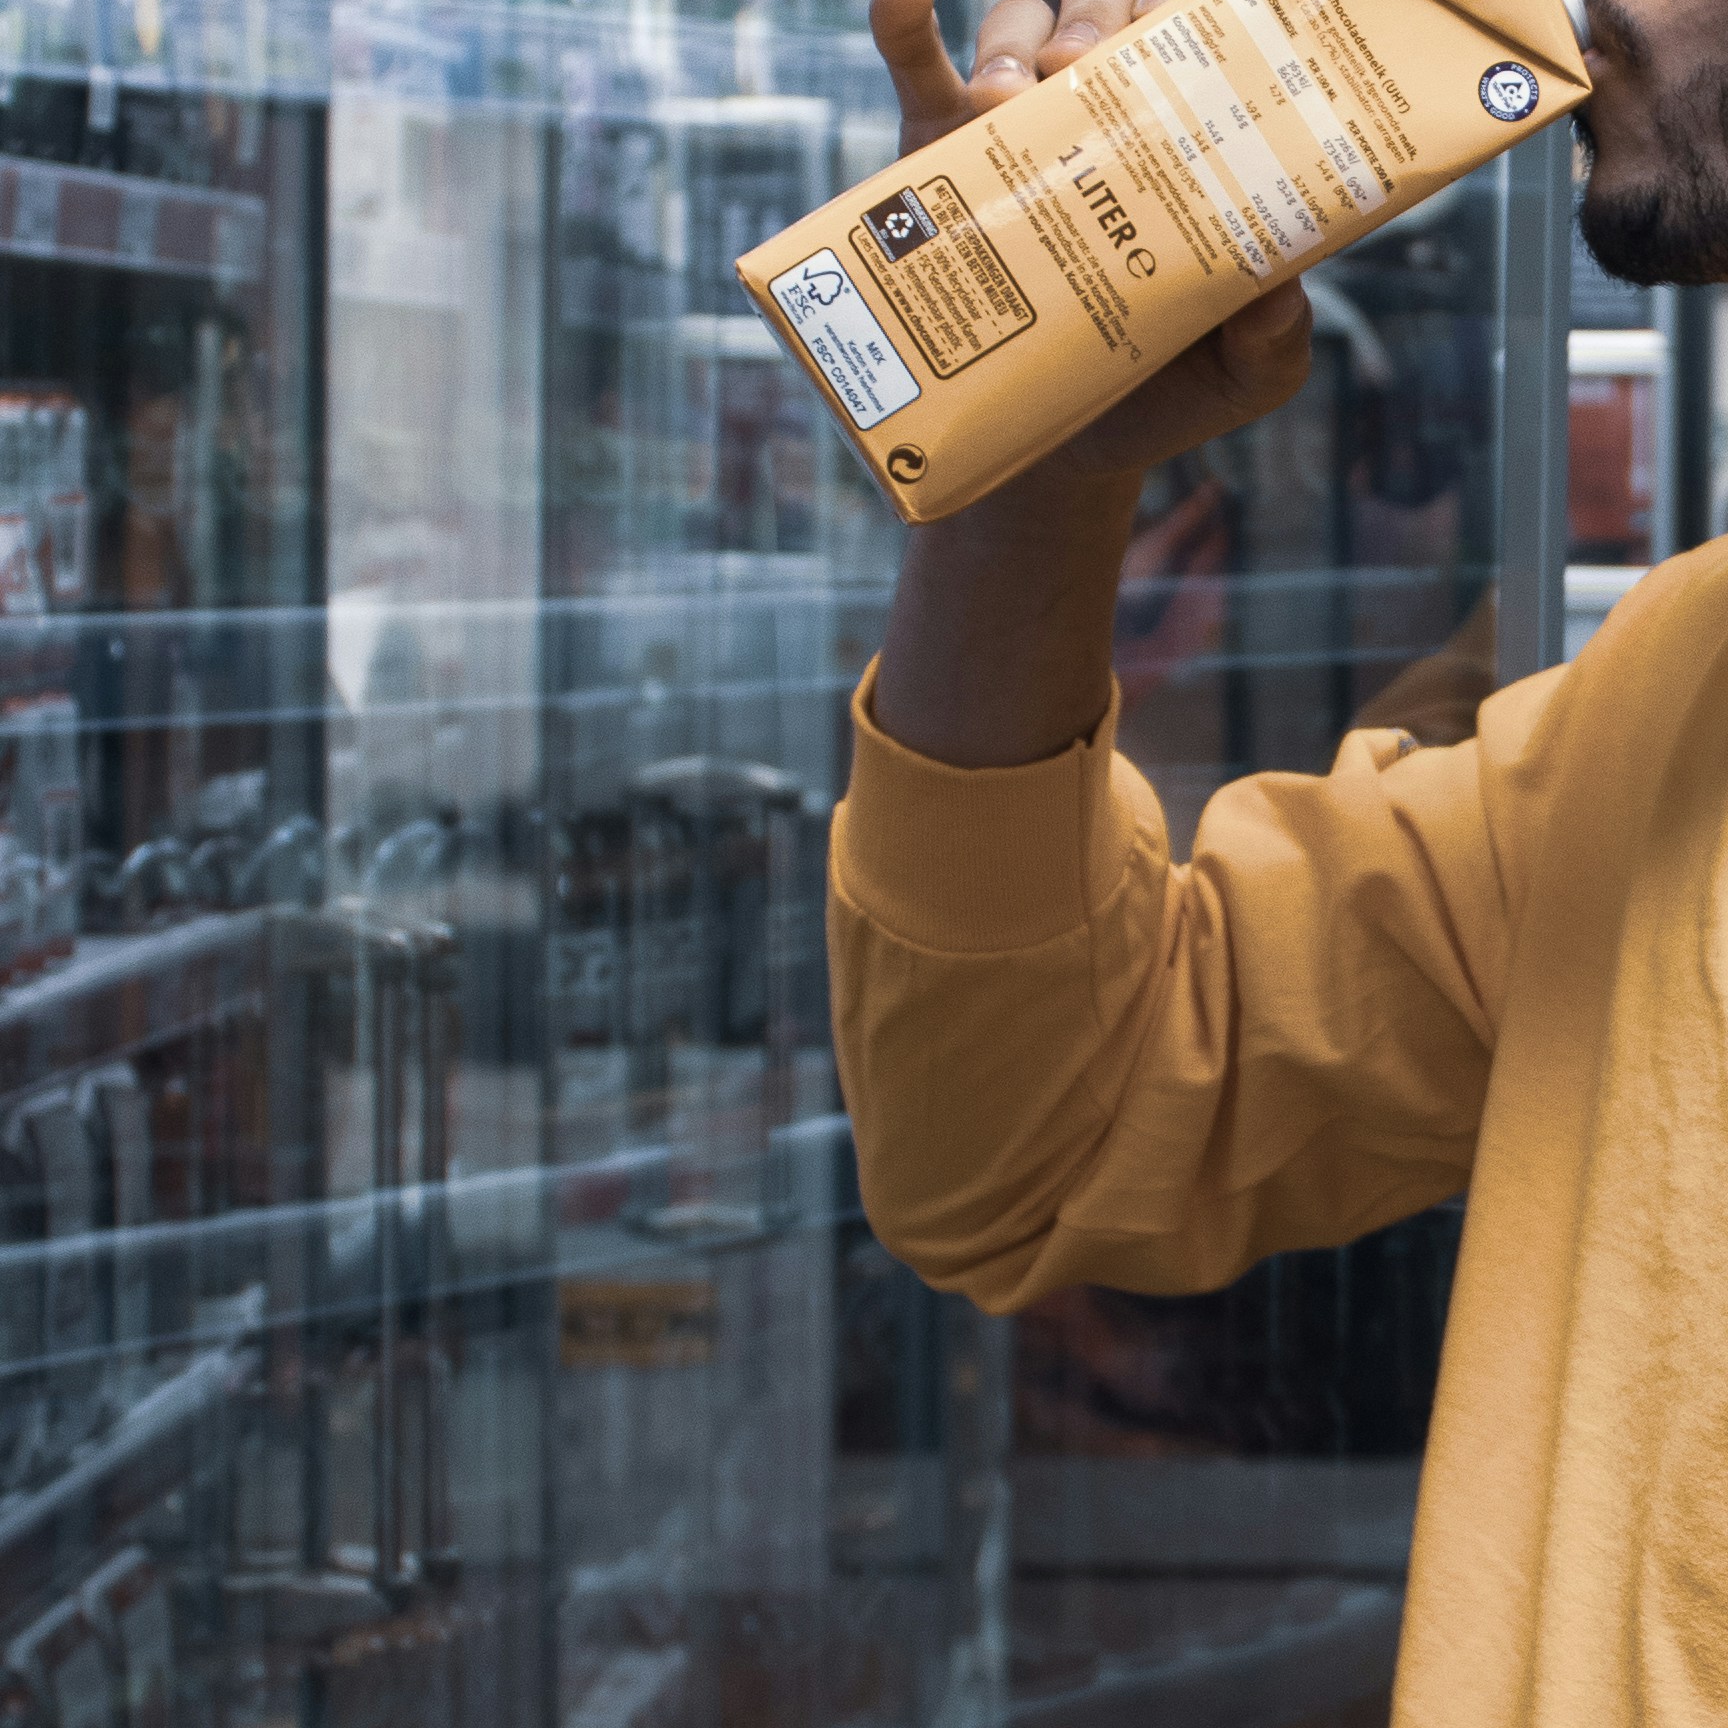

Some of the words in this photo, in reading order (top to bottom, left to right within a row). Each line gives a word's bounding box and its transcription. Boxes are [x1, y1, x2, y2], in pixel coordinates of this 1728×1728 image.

[1118, 46, 1137, 68] Zout
[1171, 14, 1210, 68] Koolhydraten
[1283, 76, 1302, 97] kcal
[1322, 137, 1337, 156] 173
[1331, 152, 1350, 173] kcal
[1284, 59, 1302, 78] 363
[1333, 134, 1352, 153] 726
[1306, 56, 1321, 74] PER
[1315, 73, 1330, 89] 100
[1324, 87, 1337, 102] ML
[1346, 118, 1361, 137] PER
[1355, 134, 1379, 165] PORTIE
[1372, 162, 1388, 181] 200
[1381, 177, 1395, 194] ML
[1327, 25, 1366, 78] gedeeltelijk
[1361, 78, 1401, 133] afgeroomde
[1397, 132, 1417, 162] melk,
[1337, 63, 1375, 118] stabilisator:
[1372, 117, 1405, 164] carrageen
[1380, 78, 1411, 114] (UHT)
[1056, 144, 1084, 167] 1
[1072, 166, 1137, 249] LITER
[1105, 55, 1131, 88] Calcium
[1159, 138, 1174, 156] 100
[1169, 153, 1183, 170] mg
[1207, 213, 1223, 232] 200
[1218, 229, 1232, 247] mg
[1114, 147, 1147, 194] verpakking
[934, 183, 953, 203] MET
[945, 200, 967, 225] ONZE
[961, 226, 1007, 288] VERPAKKINGEN
[999, 285, 1029, 321] DRAAGT
[984, 145, 1005, 171] Goed
[998, 169, 1031, 214] schudden
[1027, 212, 1045, 234] voor
[1037, 233, 1068, 272] gebruik.
[1063, 270, 1086, 297] Koud
[1079, 294, 1095, 313] het
[1089, 310, 1118, 352] lekkerst.
[985, 121, 996, 136] Na
[991, 134, 1019, 171] opening
[1032, 196, 1055, 224] dagen
[1050, 222, 1081, 264] houdbaar
[1081, 272, 1094, 286] de
[1089, 283, 1114, 318] koeling
[1019, 147, 1034, 166] Ten
[1050, 195, 1079, 238] houdbaar
[1075, 236, 1090, 256] tot:
[1086, 253, 1100, 270] zie
[1095, 267, 1130, 320] bovenzijde.
[1136, 158, 1167, 202] Dagelijkse
[1164, 201, 1213, 276] Referentie-inname
[1147, 152, 1161, 169] een
[1155, 168, 1190, 215] gemiddelde
[1185, 214, 1218, 260] volwassene
[786, 282, 816, 319] FSC
[856, 231, 874, 253] Lees
[871, 251, 888, 273] meer
[882, 272, 897, 290] op:
[892, 287, 951, 370] www.chocomel.nl
[902, 261, 945, 322] Hernieuwbaar
[935, 320, 963, 351] plastic
[931, 245, 952, 273] 100%
[945, 269, 982, 321] Recyclebaar
[942, 222, 962, 243] AAN
[954, 239, 973, 260] EEN
[965, 256, 990, 287] BETER
[982, 283, 1009, 316] MILIEU
[823, 323, 860, 376] verantwoorde
[857, 375, 885, 413] herkomst
[846, 339, 867, 367] Karton
[864, 368, 877, 384] van
[865, 340, 886, 365] MIX
[959, 321, 982, 352] Karton
[830, 365, 867, 412] C014047
